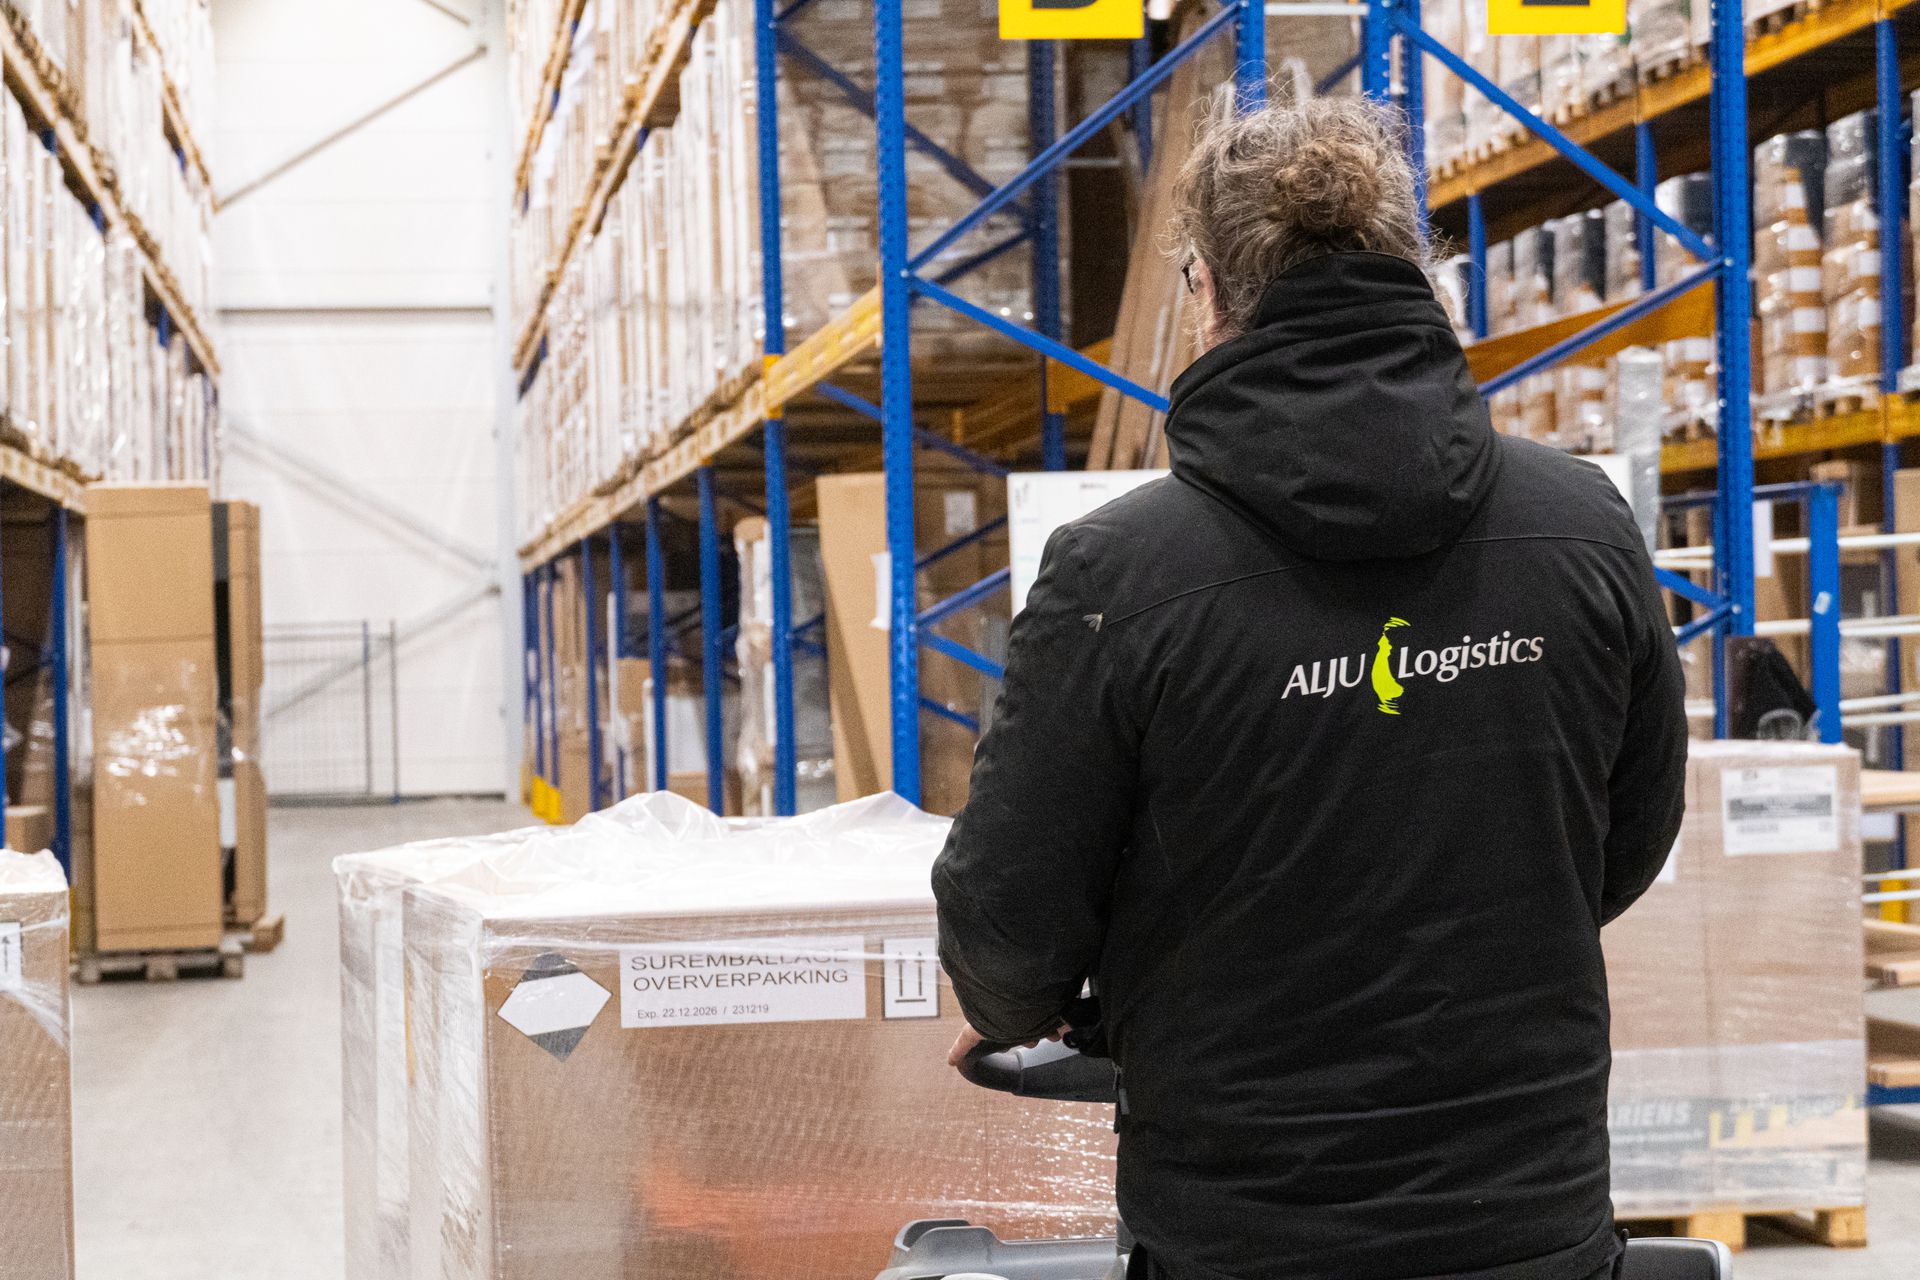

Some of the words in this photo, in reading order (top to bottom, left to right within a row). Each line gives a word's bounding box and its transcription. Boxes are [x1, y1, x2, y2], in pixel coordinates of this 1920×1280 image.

[1281, 653, 1366, 699] ALJU
[1397, 630, 1544, 682] Logistics
[633, 968, 848, 992] OVERVERPAKKING
[637, 1009, 659, 1020] Exp.
[662, 1006, 718, 1018] 22.12.2026
[732, 1003, 769, 1015] 231219
